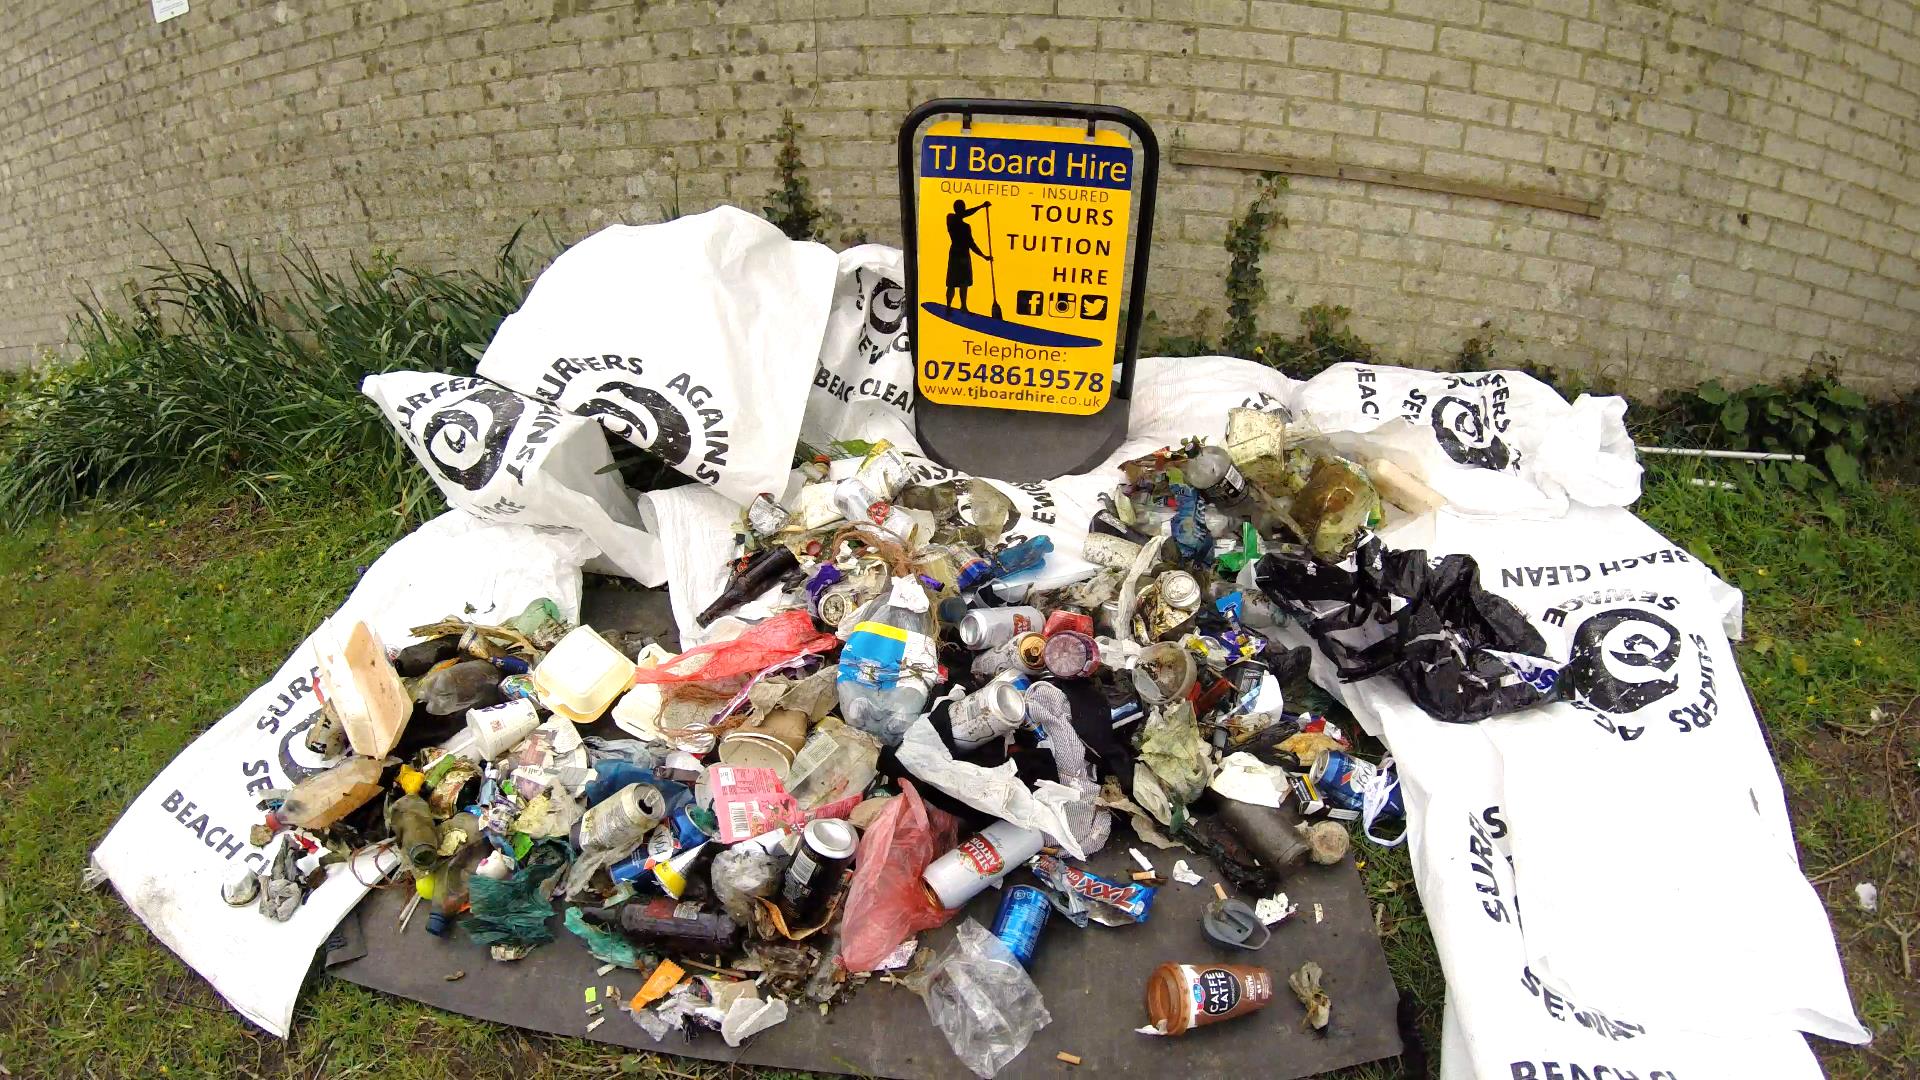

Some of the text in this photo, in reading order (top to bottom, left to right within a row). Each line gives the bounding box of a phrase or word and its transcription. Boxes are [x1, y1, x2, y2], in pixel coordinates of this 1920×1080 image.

[929, 145, 1128, 182] TJ Board Hire
[940, 181, 1020, 197] QUALIFIED
[1042, 187, 1109, 203] INSURED
[1030, 204, 1113, 226] TOURS
[1007, 234, 1111, 257] TUITION
[1053, 267, 1108, 286] HIRE
[962, 340, 1068, 363] Telephone:
[813, 366, 857, 404] BEAC
[924, 360, 1104, 393] 07548619578
[924, 384, 1101, 408] www.tjboardhire.co.uk
[1501, 549, 1690, 588] BEACH CLEAN
[160, 789, 245, 861] BEACH
[963, 841, 990, 871] STELLA
[970, 837, 998, 865] ARTOIS
[1214, 971, 1230, 1012] LATTE
